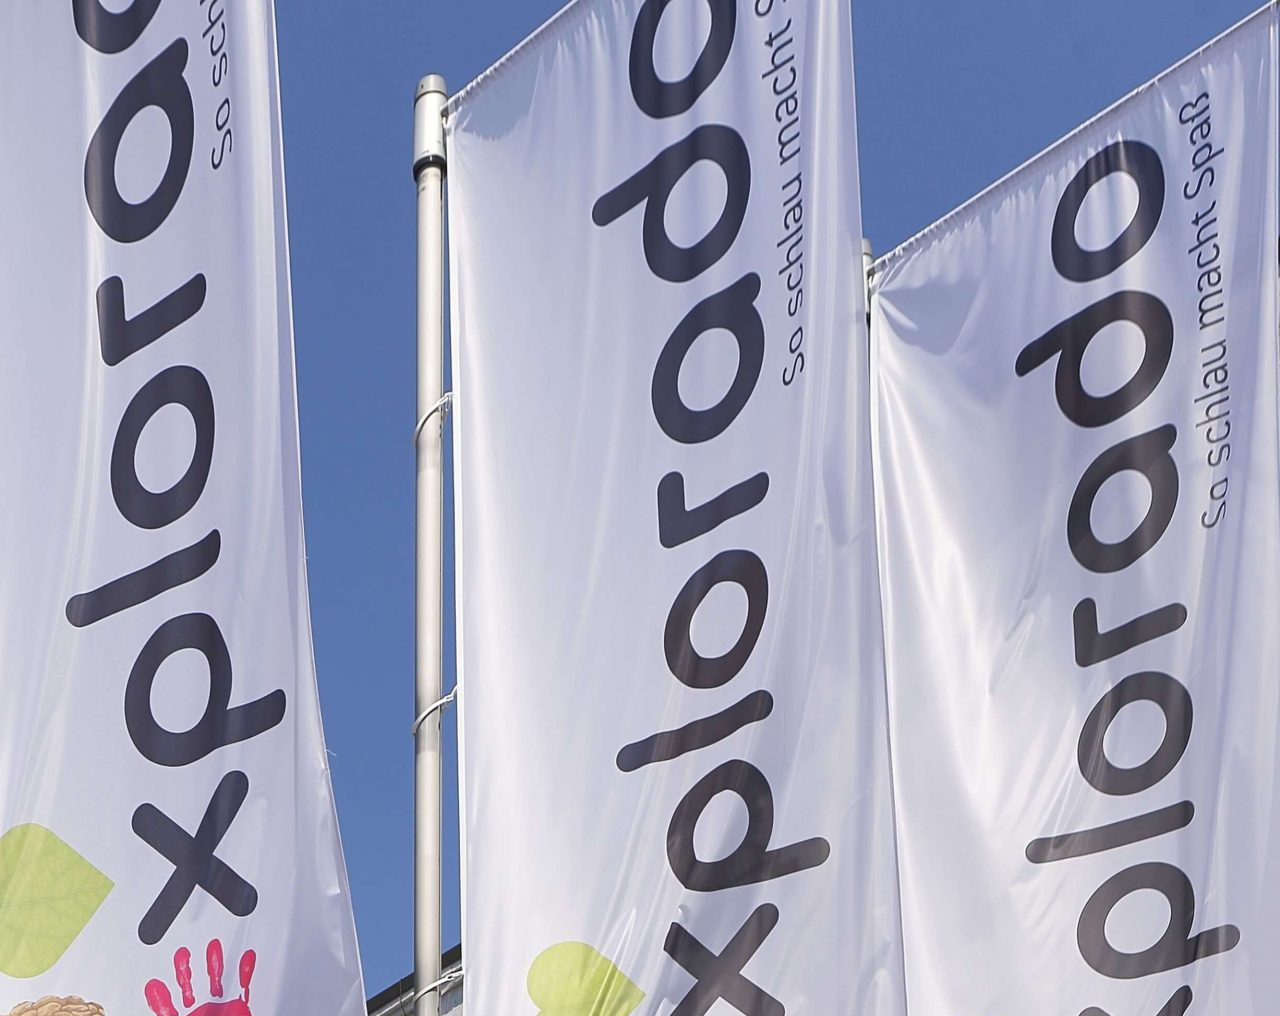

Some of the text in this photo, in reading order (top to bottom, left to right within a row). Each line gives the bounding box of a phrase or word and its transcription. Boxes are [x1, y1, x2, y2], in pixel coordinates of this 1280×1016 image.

[200, 0, 233, 170] So sch
[761, 18, 801, 166] macht
[776, 171, 805, 317] schlau
[1178, 91, 1231, 529] So schlau macht Spaß
[782, 325, 805, 386] So
[65, 0, 287, 946] xplora
